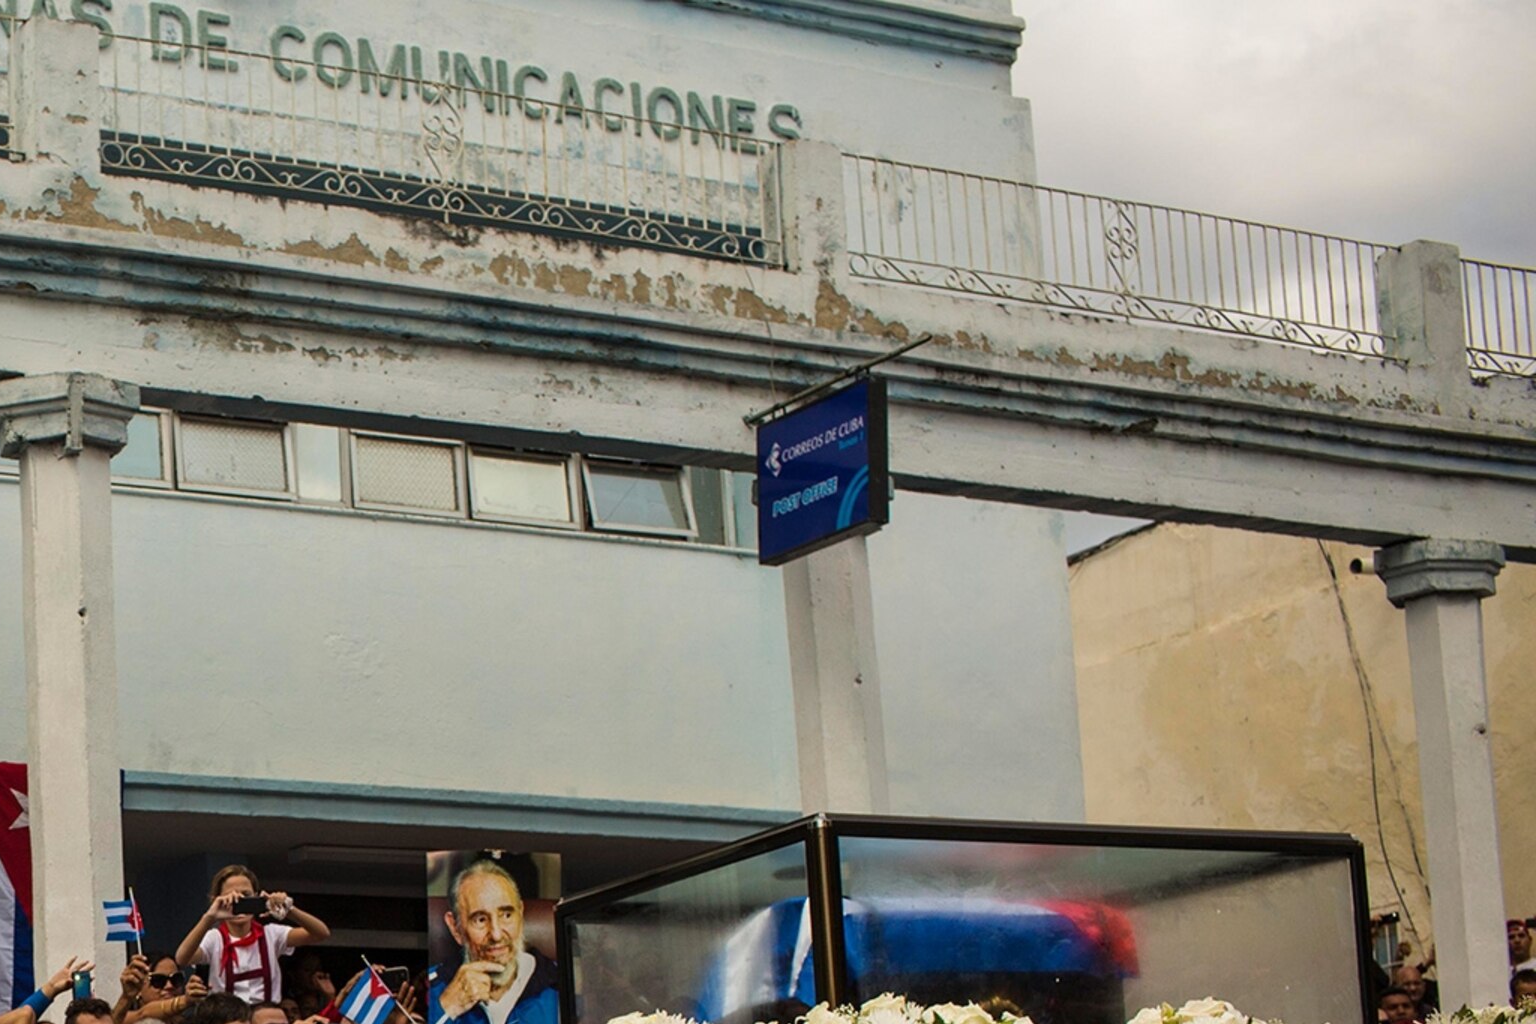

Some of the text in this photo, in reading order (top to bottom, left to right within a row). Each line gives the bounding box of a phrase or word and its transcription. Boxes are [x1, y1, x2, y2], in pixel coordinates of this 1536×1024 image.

[151, 2, 239, 72] DE
[269, 24, 803, 154] COMUNICACIONES
[781, 432, 824, 463] CORREOS
[825, 426, 838, 444] DE
[838, 415, 864, 437] CUBA
[772, 491, 802, 518] POST
